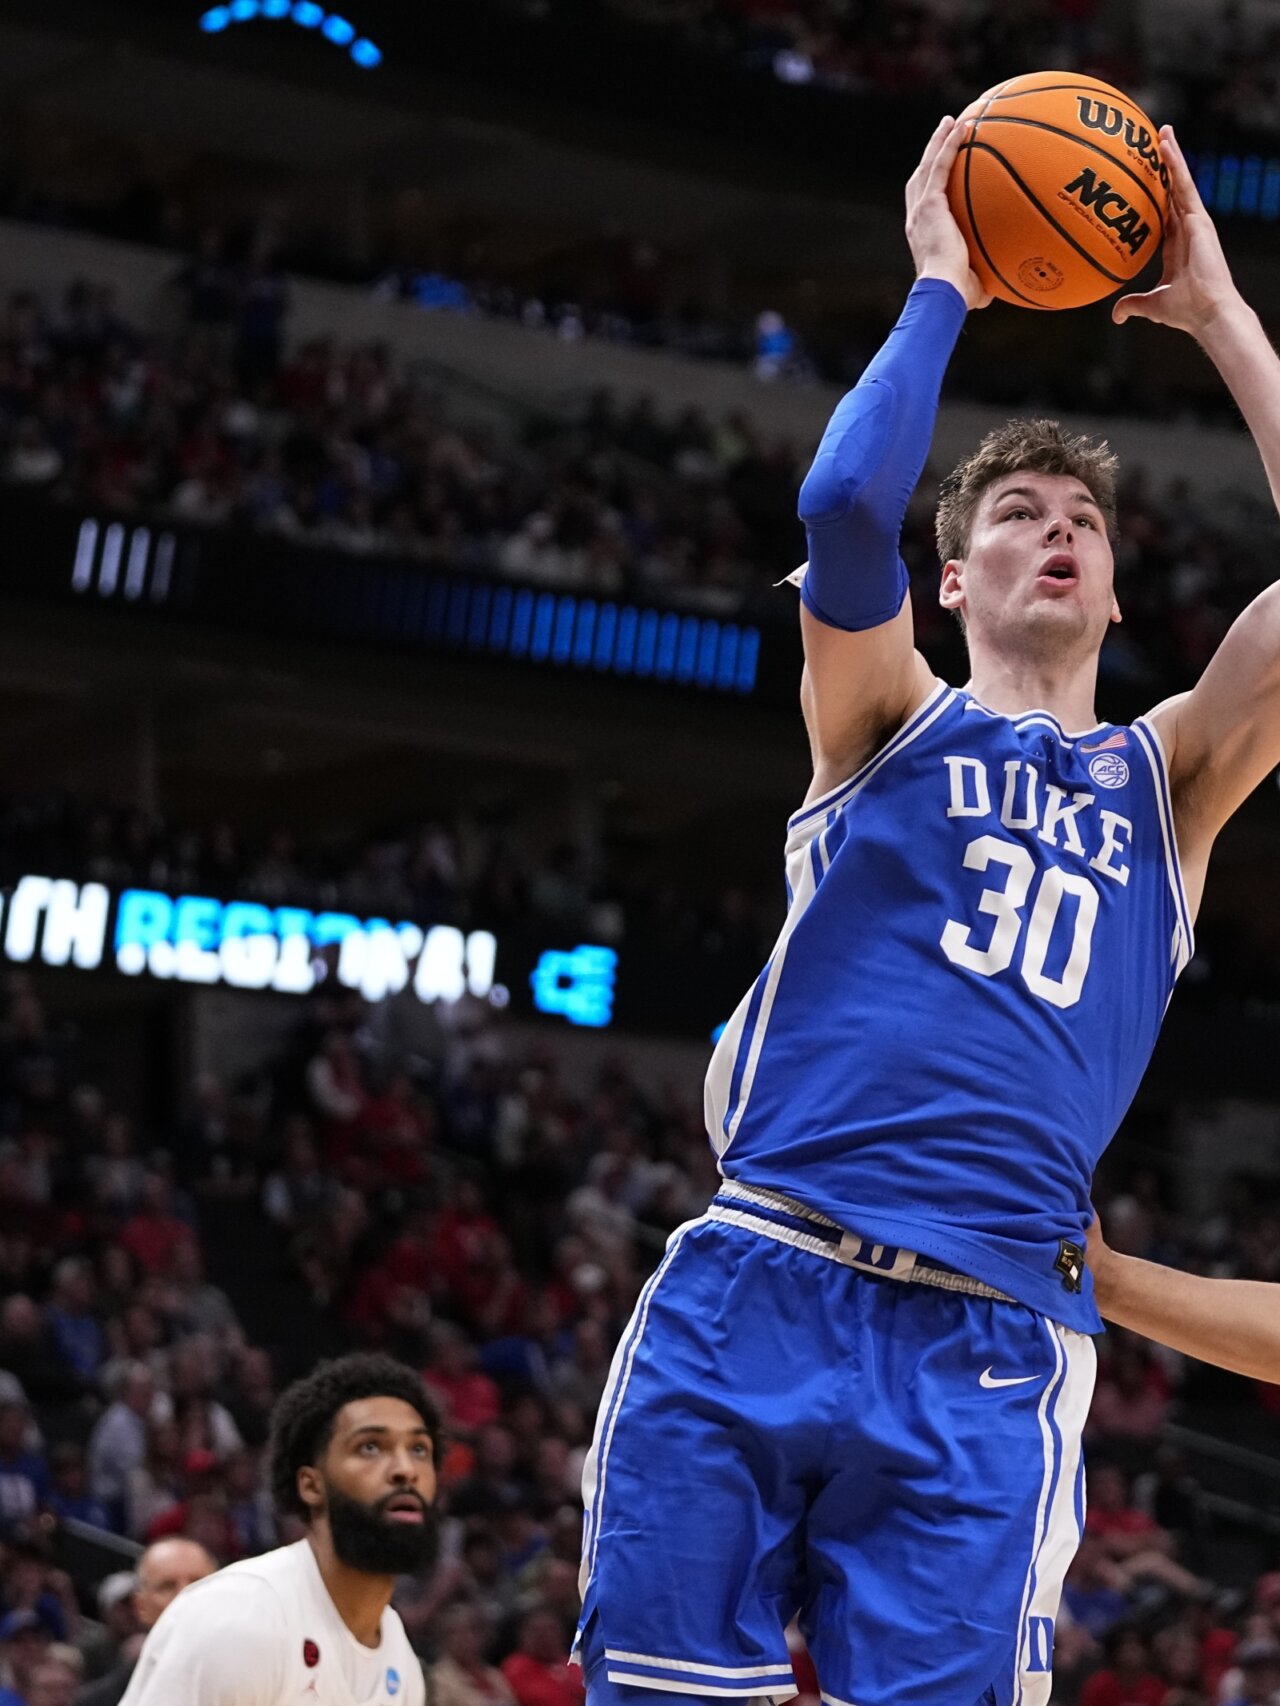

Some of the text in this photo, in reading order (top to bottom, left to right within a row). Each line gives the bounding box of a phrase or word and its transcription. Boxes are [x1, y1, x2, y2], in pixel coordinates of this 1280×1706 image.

[1076, 95, 1170, 190] Wilso
[1057, 191, 1095, 226] OFFICIAL
[1063, 167, 1152, 256] NCAA
[943, 755, 1133, 887] DUKE
[0, 875, 110, 969] TH
[939, 834, 1100, 1010] 30
